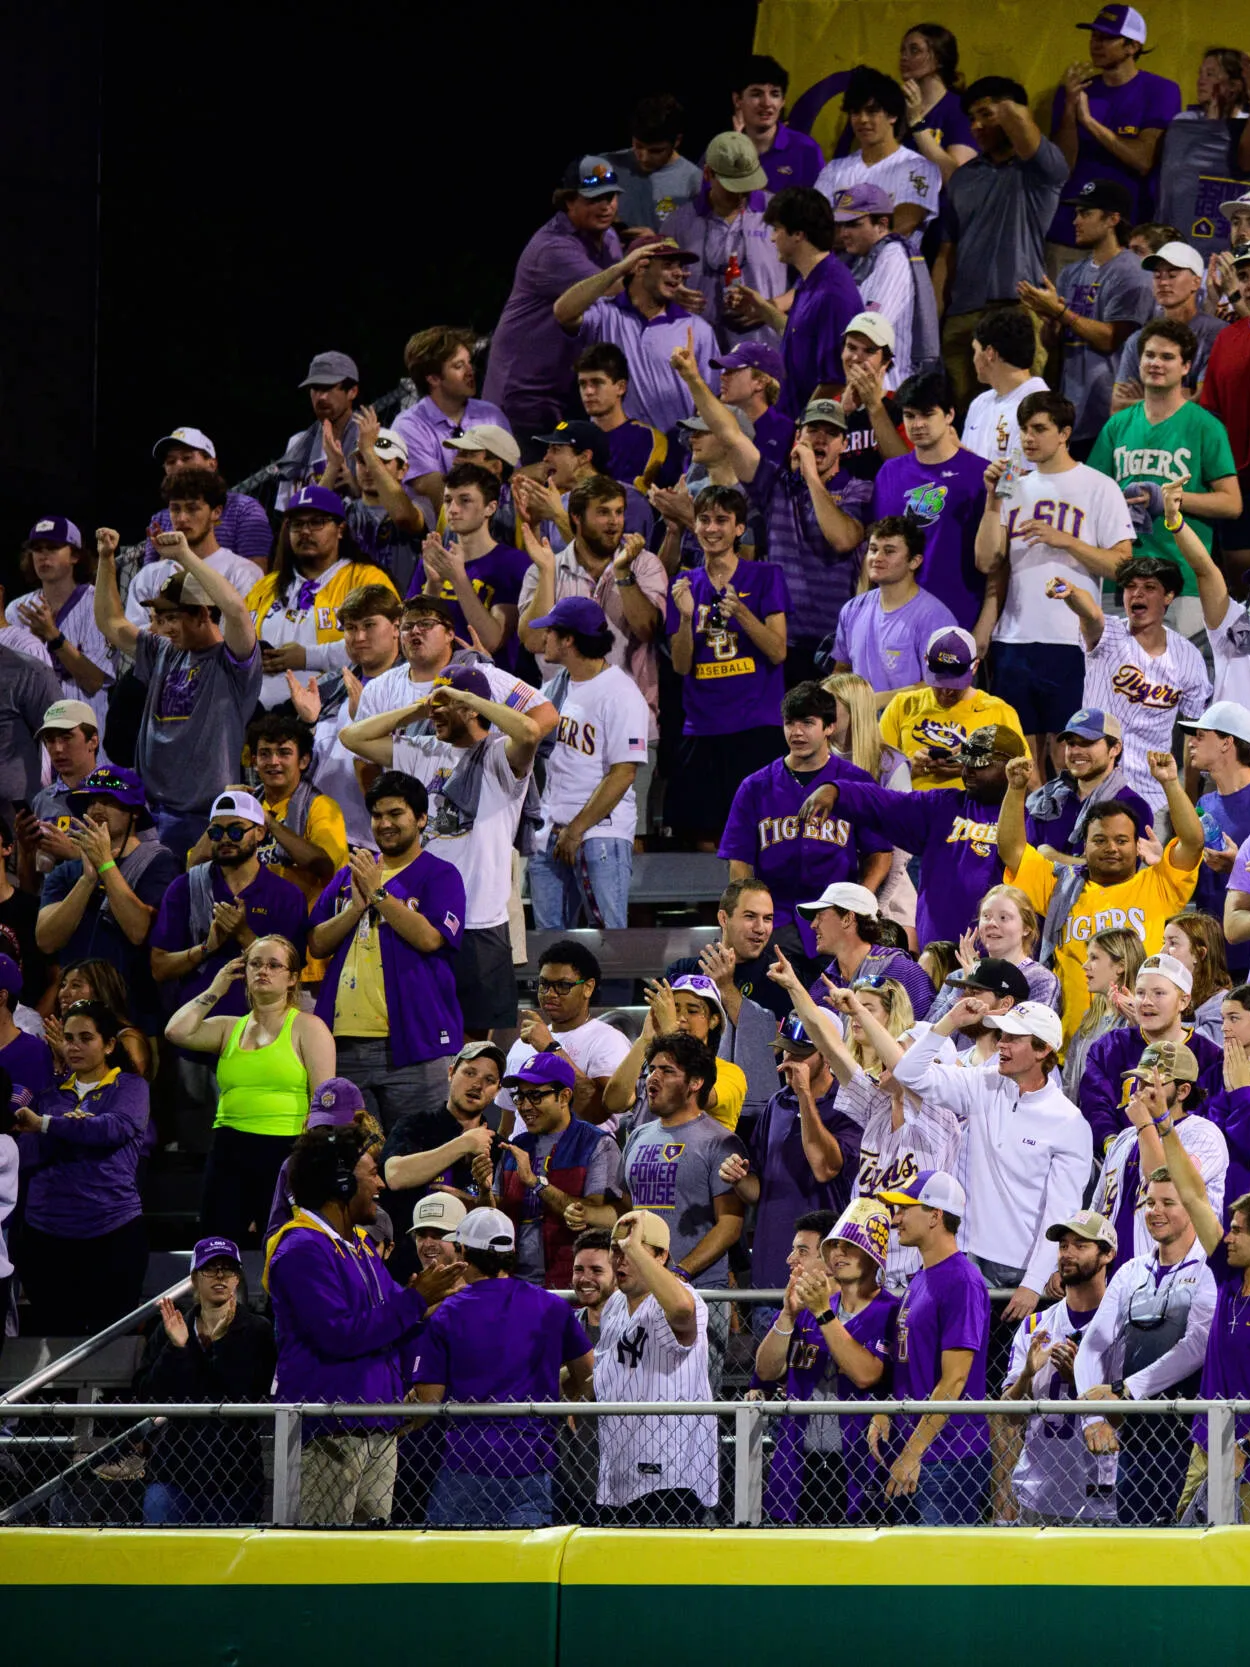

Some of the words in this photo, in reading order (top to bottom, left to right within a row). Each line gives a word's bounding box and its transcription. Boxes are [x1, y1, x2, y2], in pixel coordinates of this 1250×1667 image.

[1112, 446, 1192, 482] TIGERS
[1008, 499, 1084, 539] LSU
[1112, 664, 1182, 709] Tigers
[758, 815, 851, 852] TIGERS
[1012, 1004, 1028, 1014] SU
[635, 1143, 663, 1162] THE
[1023, 1138, 1036, 1146] LSU
[629, 1163, 678, 1183] POWER
[631, 1183, 676, 1206] HOUSE
[616, 1325, 649, 1369] NY
